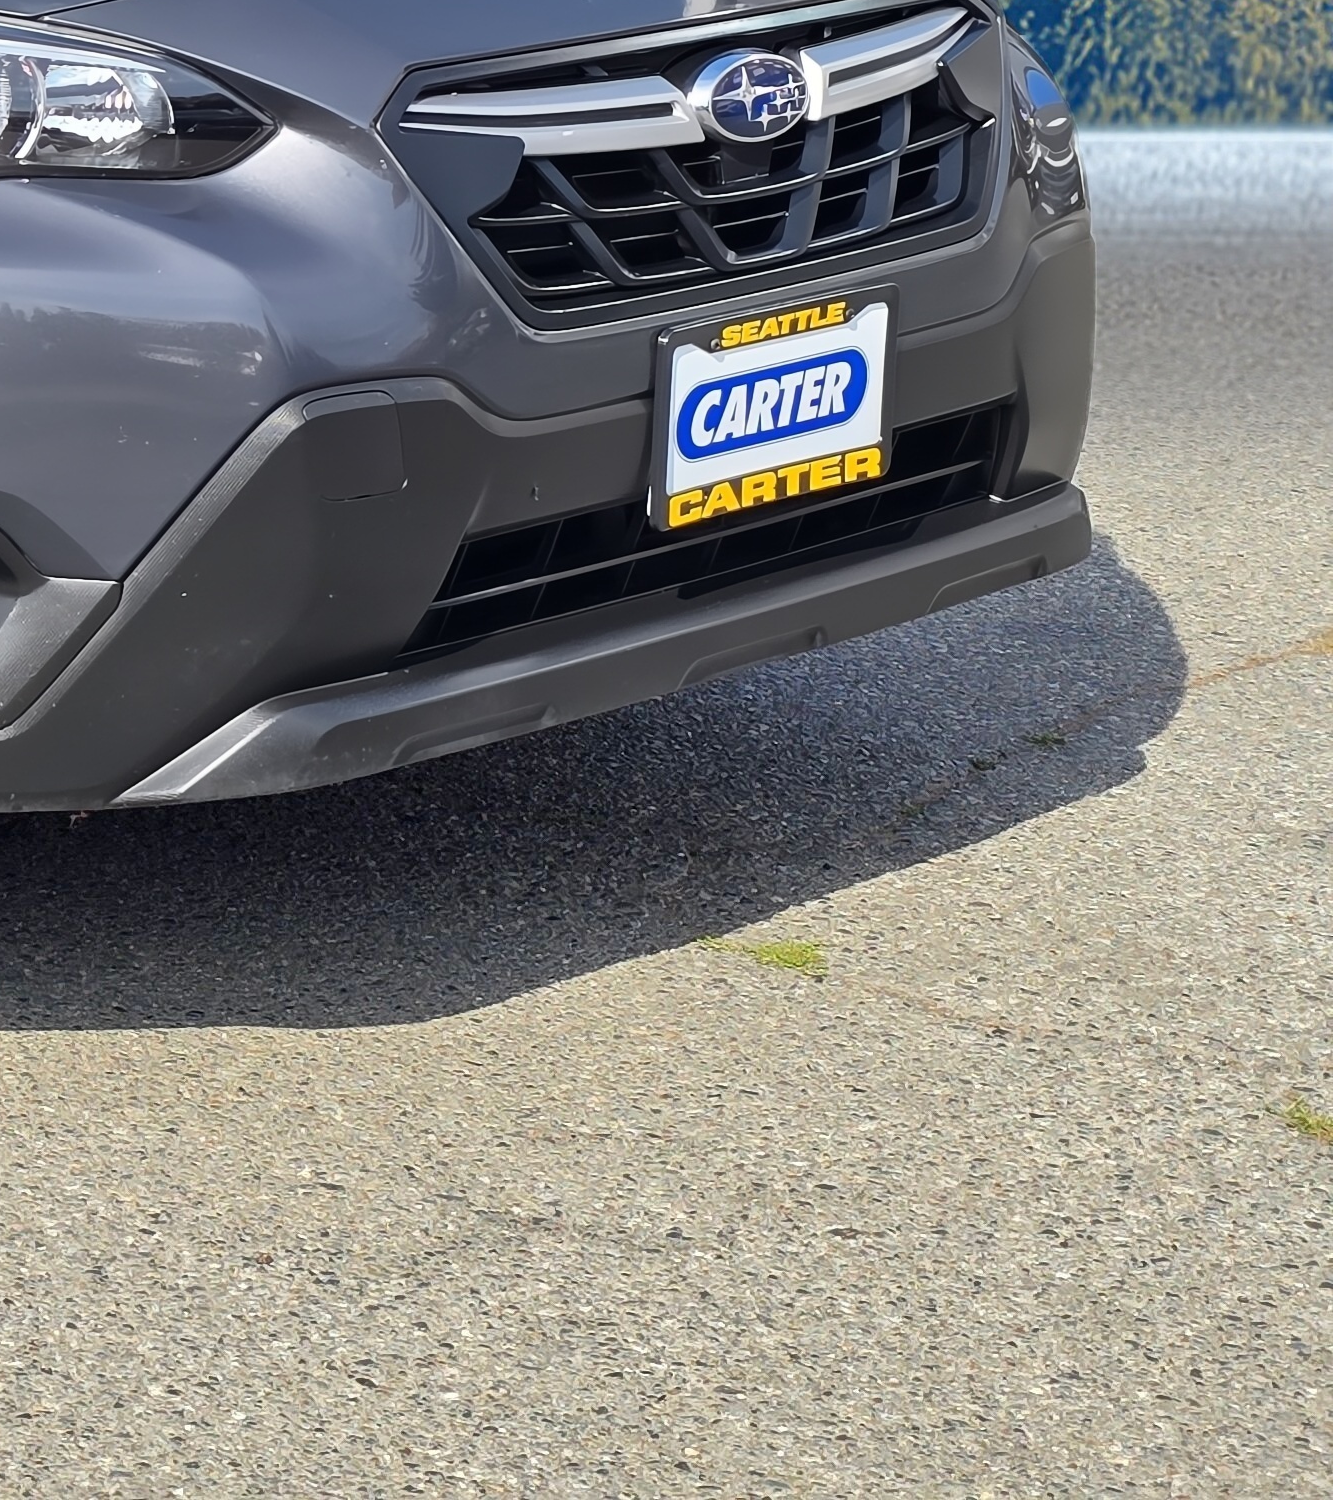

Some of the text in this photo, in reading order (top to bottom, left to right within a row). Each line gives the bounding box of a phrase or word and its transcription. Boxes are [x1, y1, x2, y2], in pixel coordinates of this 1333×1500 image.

[720, 300, 848, 349] SEATTLE
[689, 360, 853, 448] CARTER
[667, 446, 883, 529] CARTER
